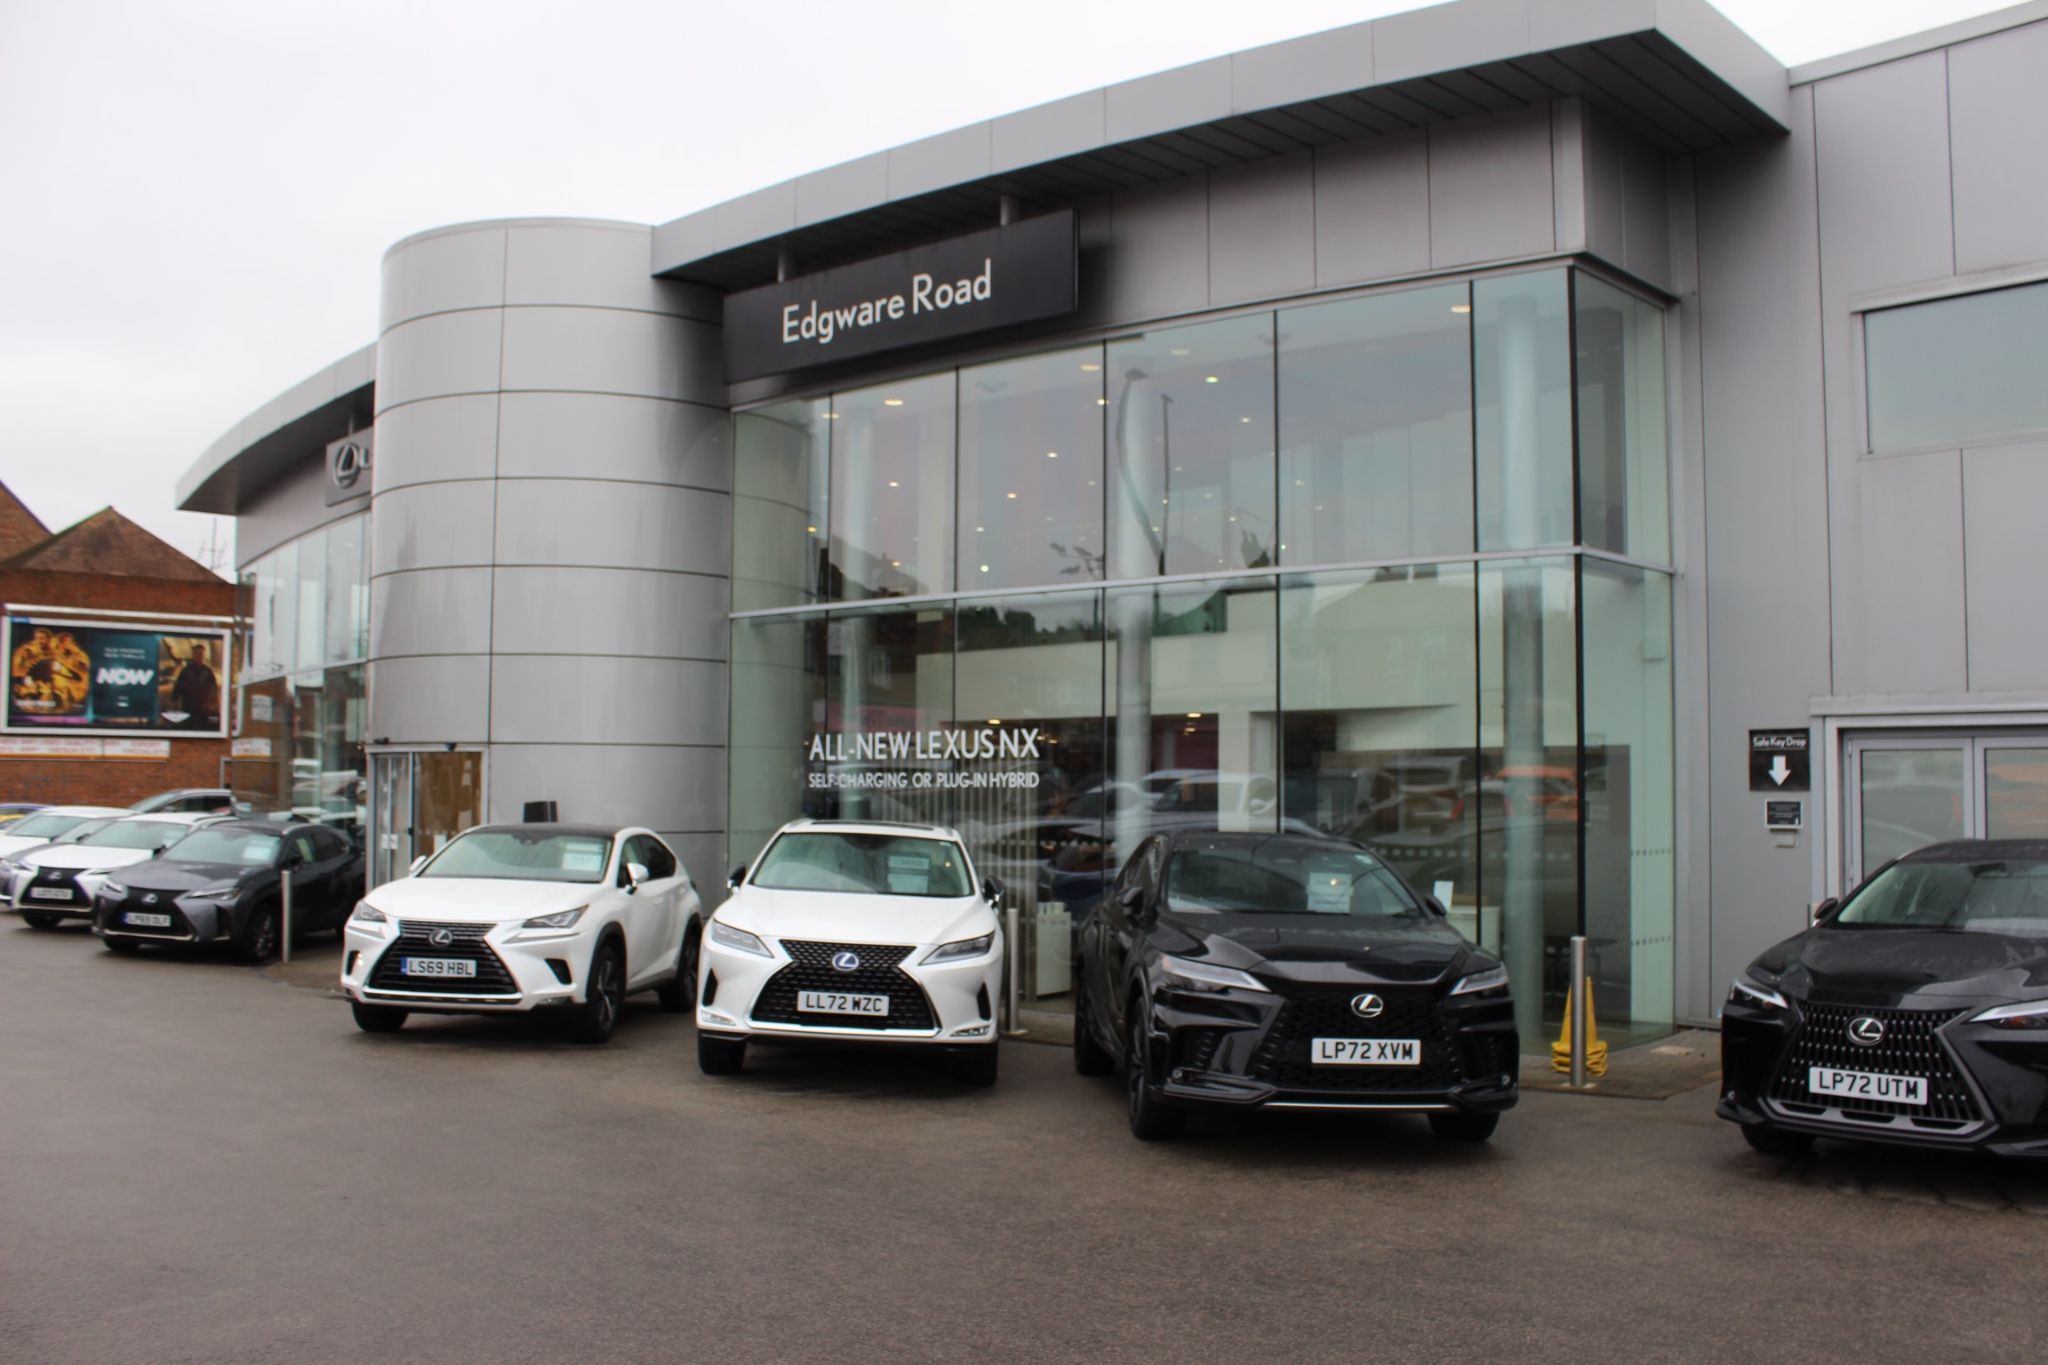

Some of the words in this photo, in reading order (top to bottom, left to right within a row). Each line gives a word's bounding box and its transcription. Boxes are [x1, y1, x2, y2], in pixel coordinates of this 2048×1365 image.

[782, 294, 905, 344] Edgware
[912, 257, 992, 314] Road
[96, 667, 155, 686] NOW
[809, 731, 911, 761] ALL-NEW
[915, 729, 995, 759] LEXUS
[999, 728, 1040, 758] NX
[1770, 735, 1785, 749] Key
[1786, 735, 1806, 749] Drop
[808, 772, 908, 789] SELF-CHARGING
[912, 772, 932, 788] OR
[936, 772, 988, 788] PLUG-IN
[989, 772, 1040, 788] HYBRID
[408, 960, 443, 974] LS69
[446, 961, 473, 976] HBL
[805, 994, 848, 1010] LL72
[851, 996, 883, 1013] WZC
[1321, 1041, 1372, 1059] LP72
[1377, 1042, 1413, 1060] XVM
[1818, 1071, 1871, 1094] LP72
[1877, 1077, 1918, 1099] UTM
